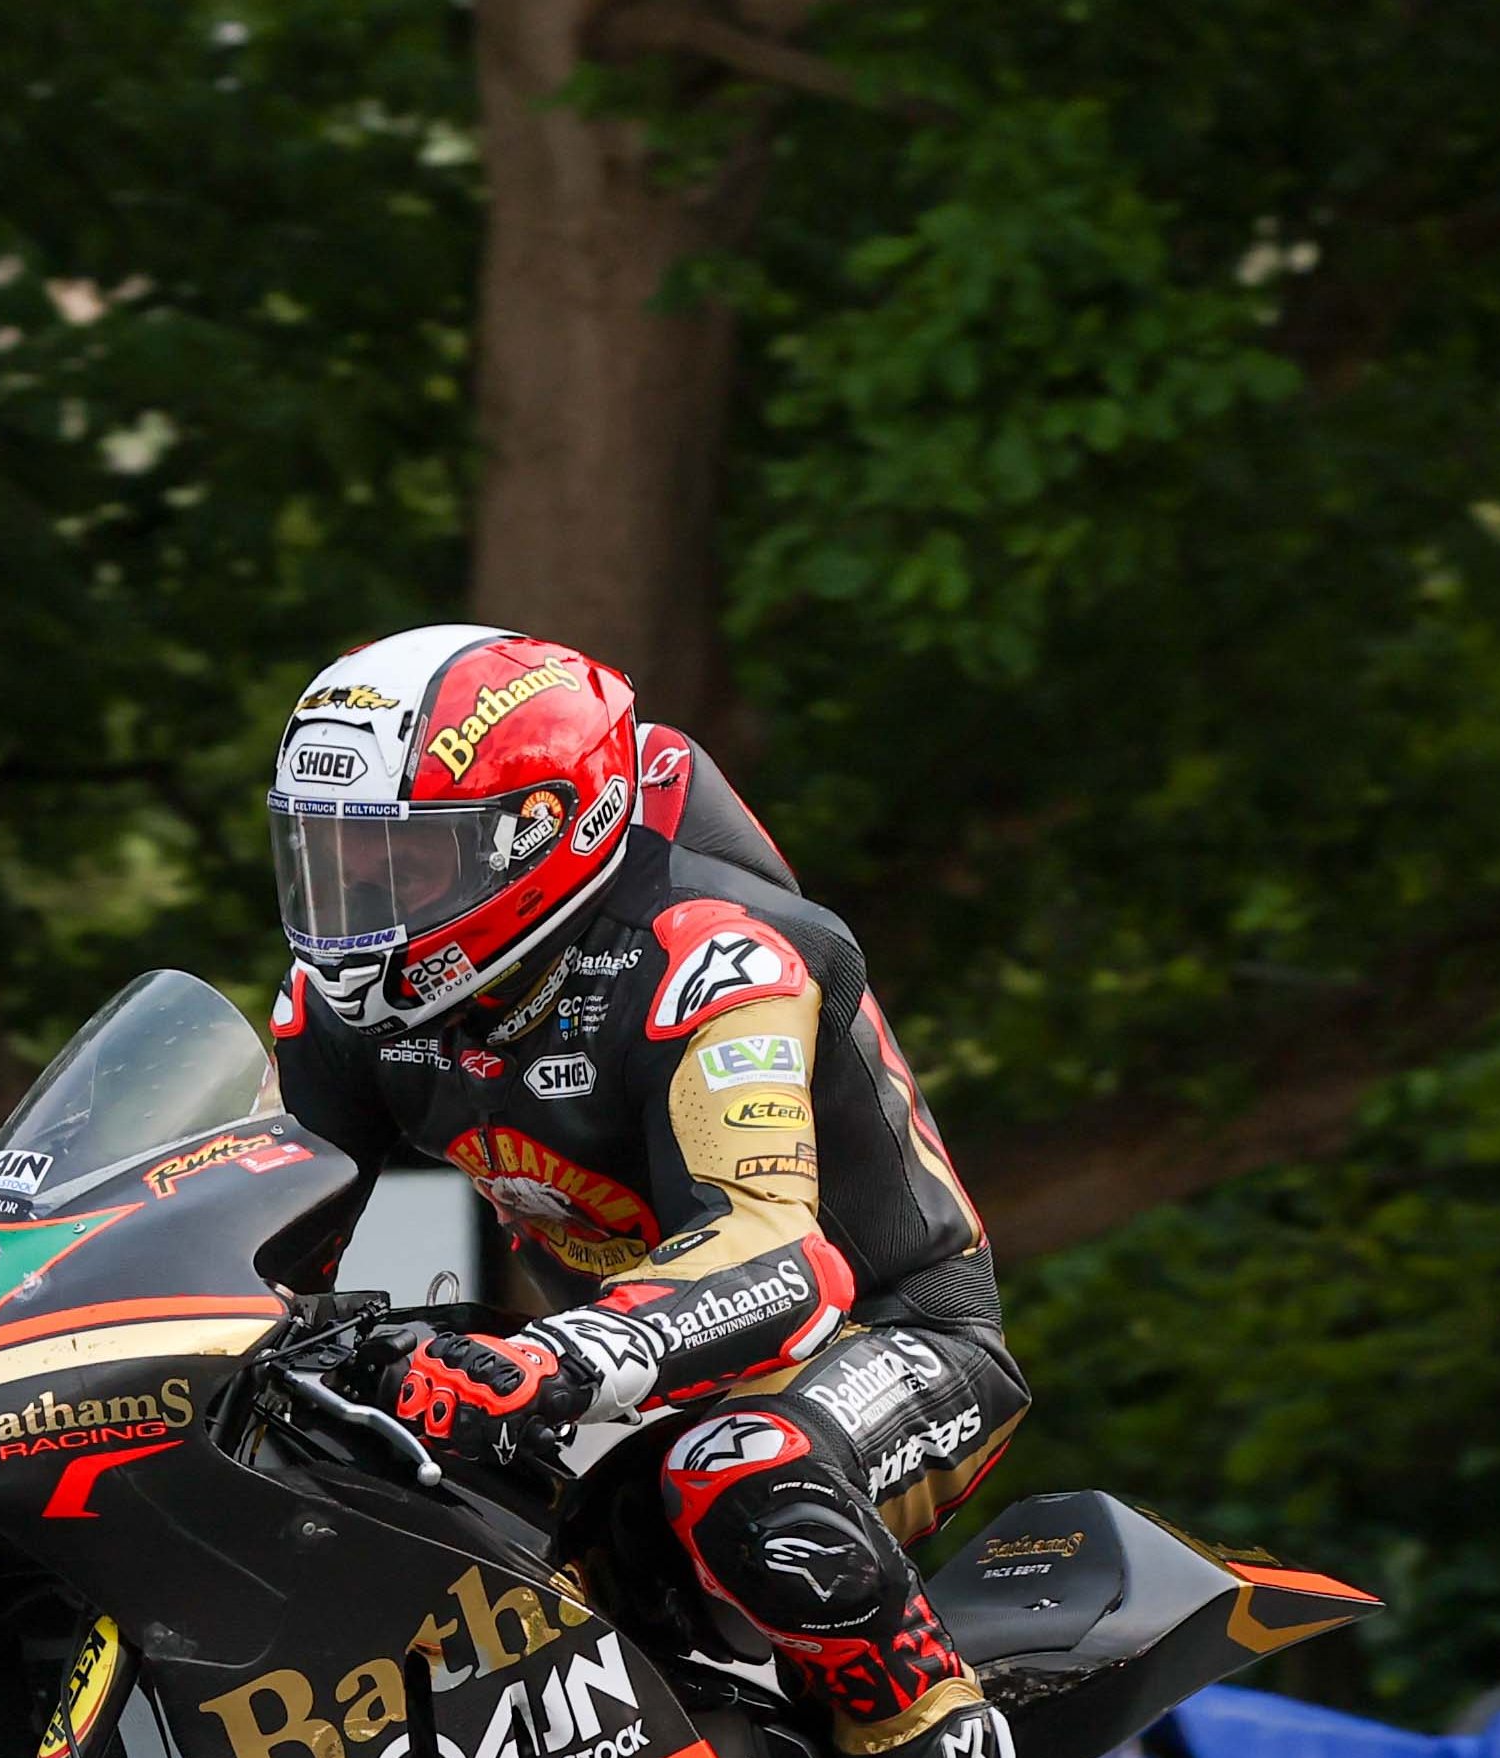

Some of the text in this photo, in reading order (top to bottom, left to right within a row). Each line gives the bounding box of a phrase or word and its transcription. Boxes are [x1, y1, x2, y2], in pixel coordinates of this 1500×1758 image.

[296, 750, 355, 779] SHOEI
[294, 801, 336, 813] KELTRUCK
[344, 804, 399, 815] KELTRUCK
[581, 784, 624, 847] SHOEI
[512, 818, 554, 857] SHOEI
[407, 945, 464, 985] ebc
[426, 972, 473, 1003] group
[683, 1296, 793, 1350] PRIZEWINNING ALES
[0, 1421, 169, 1461] RACING
